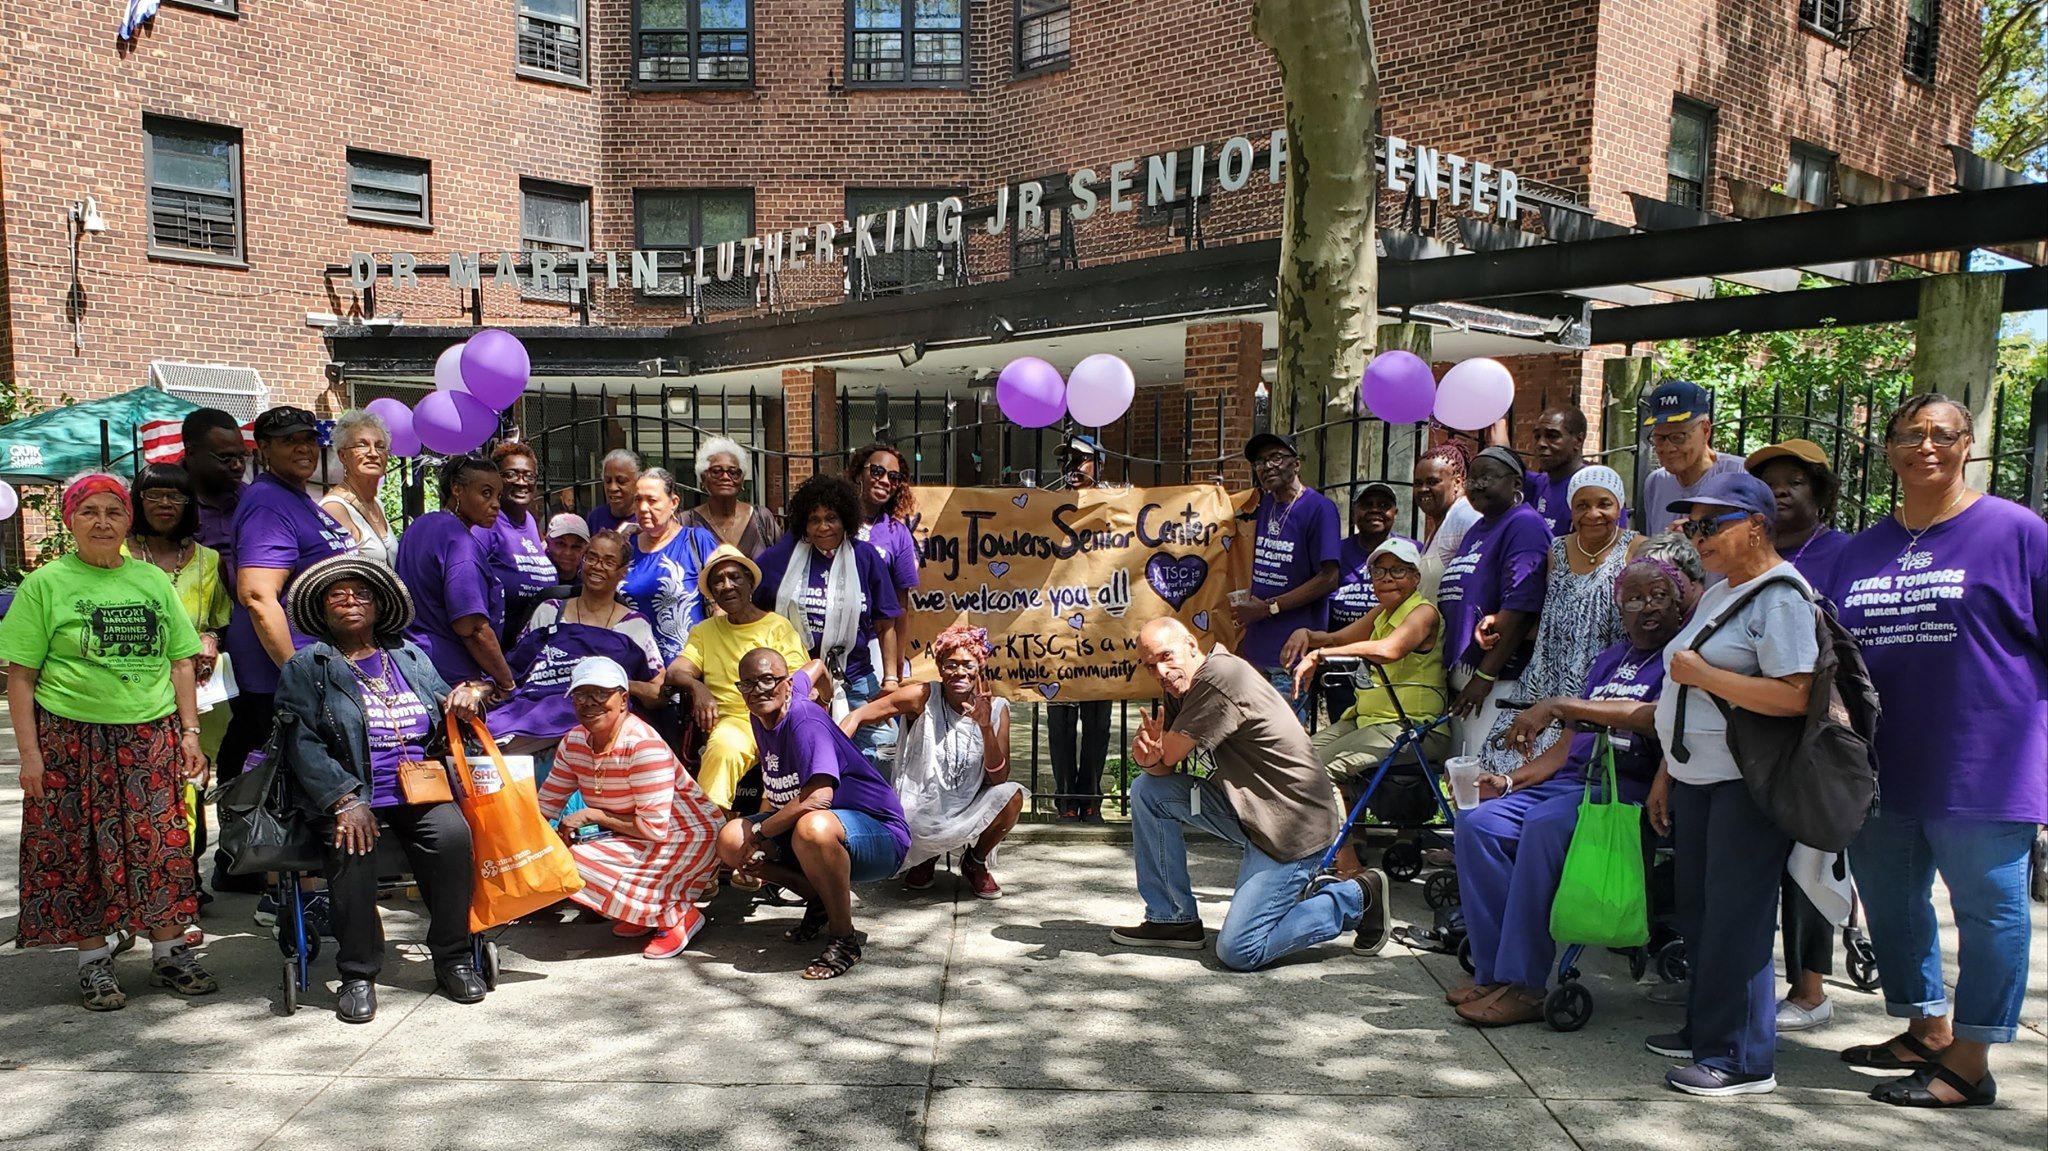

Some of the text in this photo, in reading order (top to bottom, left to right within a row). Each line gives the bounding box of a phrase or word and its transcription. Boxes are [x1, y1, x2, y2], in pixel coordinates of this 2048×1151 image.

[351, 251, 418, 290] DR
[449, 250, 660, 290] MARTIN
[694, 221, 836, 286] LUTHER
[854, 195, 964, 260] KING
[987, 180, 1045, 237] JR
[1384, 134, 1519, 221] ENTER
[961, 510, 1051, 566] Towers
[1051, 502, 1136, 560] Senior
[1136, 502, 1218, 549] Center
[1153, 566, 1189, 581] KTSC
[911, 568, 1129, 618] we welcome you all
[100, 608, 144, 618] VICTORY
[104, 625, 147, 634] JARDINES
[1879, 625, 1894, 634] Not
[1894, 623, 1919, 633] Senior
[1919, 621, 1958, 632] Citizens,
[115, 634, 151, 642] TRIUNFO
[1874, 634, 1914, 646] SEASONED
[1006, 633, 1067, 660] KTSC,
[1076, 635, 1095, 657] is
[1100, 637, 1115, 652] a
[984, 664, 1003, 681] he
[1007, 660, 1051, 681] whole
